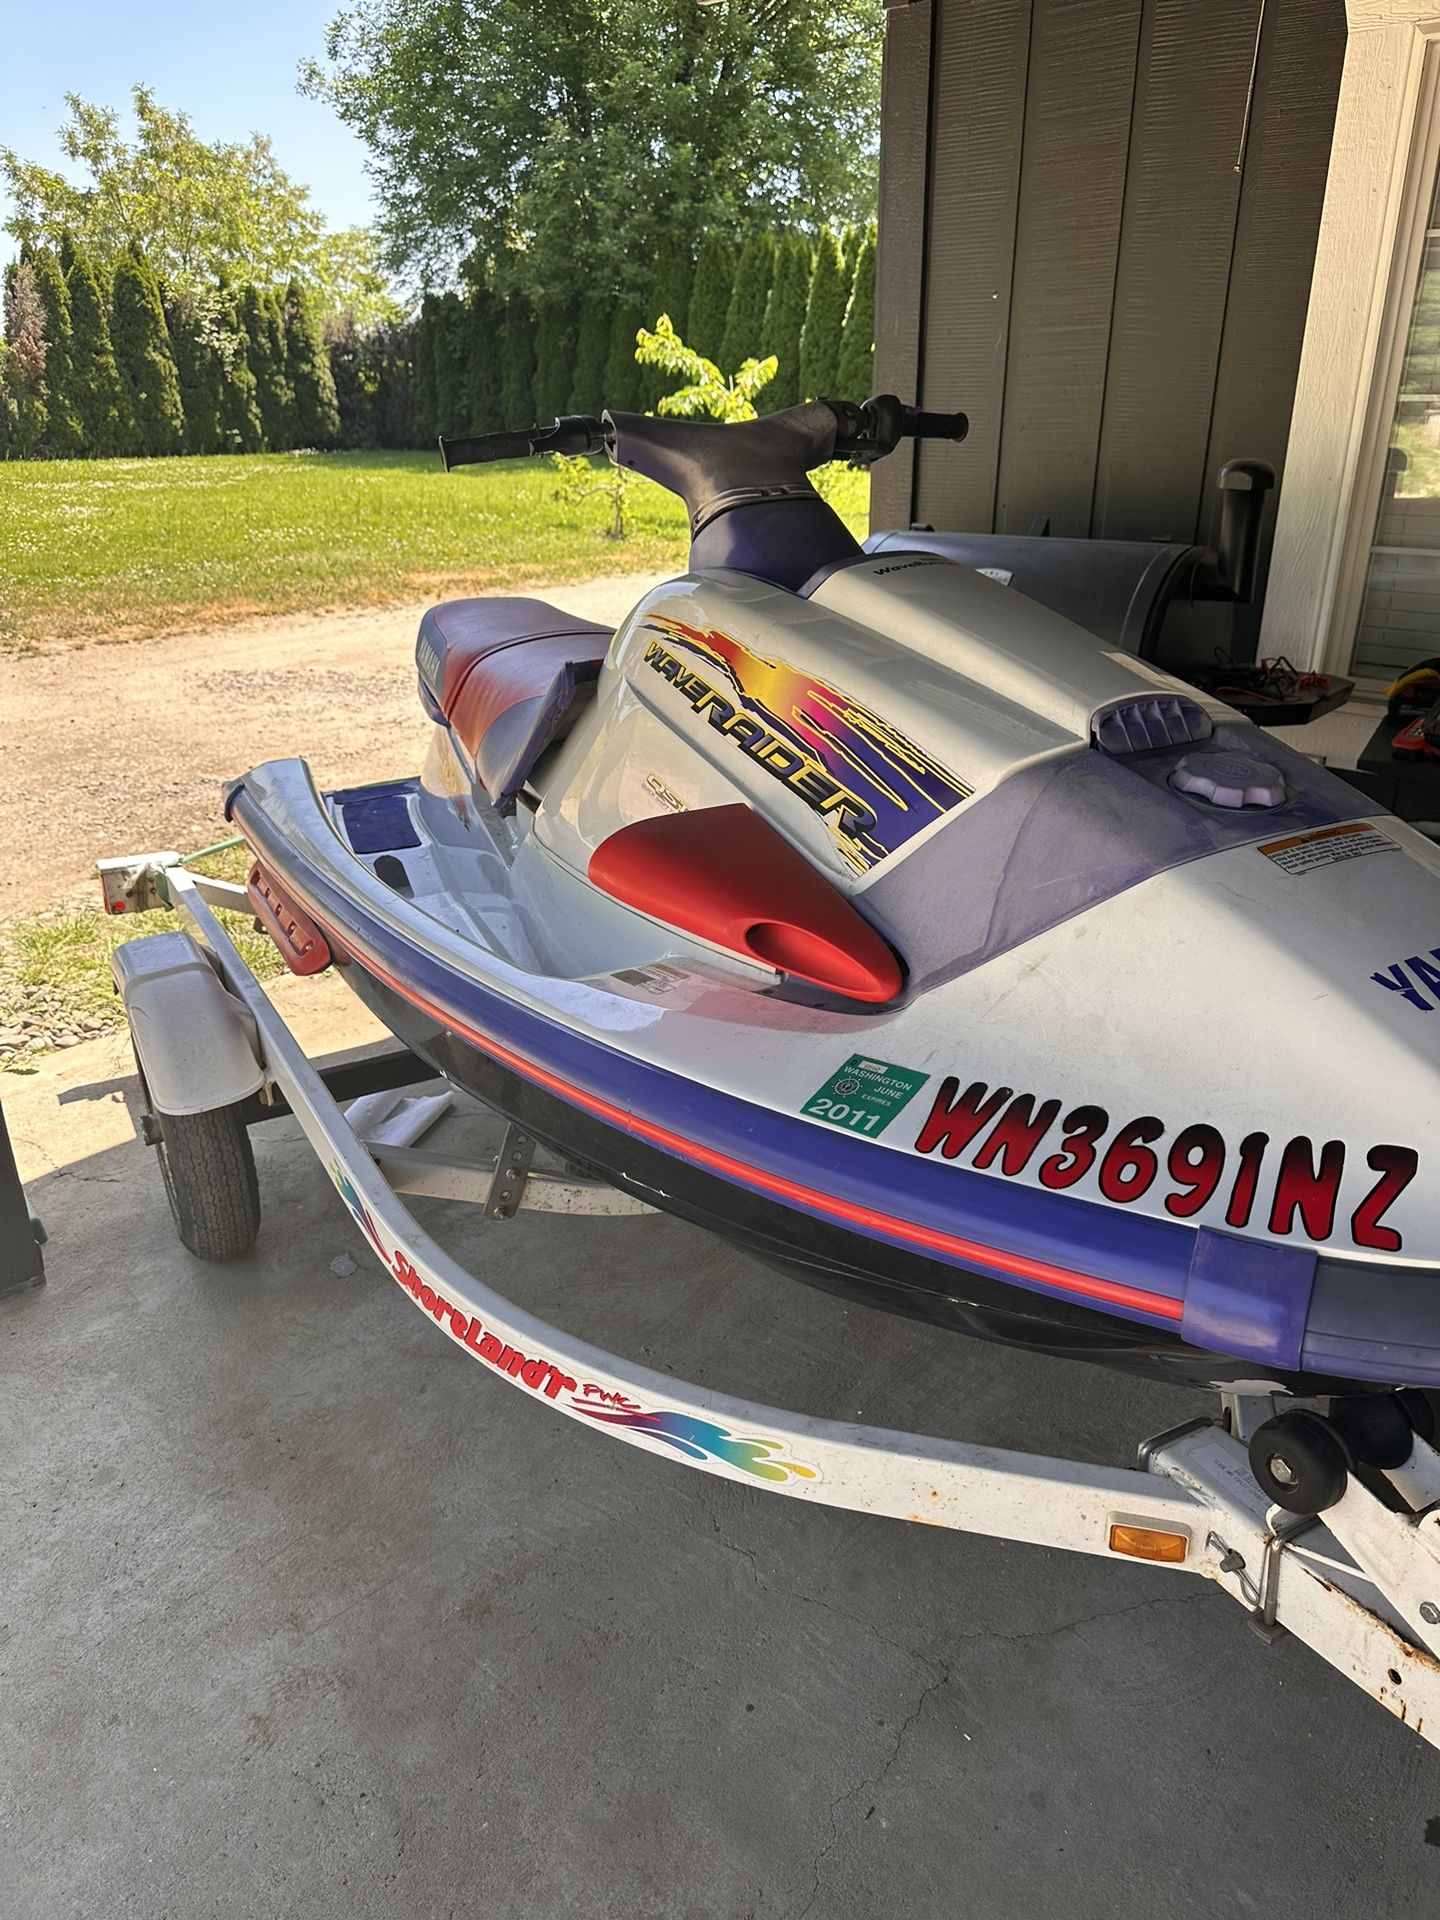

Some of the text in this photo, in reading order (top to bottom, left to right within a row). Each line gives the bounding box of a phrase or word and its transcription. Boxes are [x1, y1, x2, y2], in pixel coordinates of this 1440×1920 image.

[1370, 948, 1440, 1011] YA
[844, 1066, 912, 1091] WASHINGTON
[861, 1093, 892, 1107] EXPIRES
[874, 1086, 904, 1099] JUNE
[808, 1098, 880, 1131] 2011
